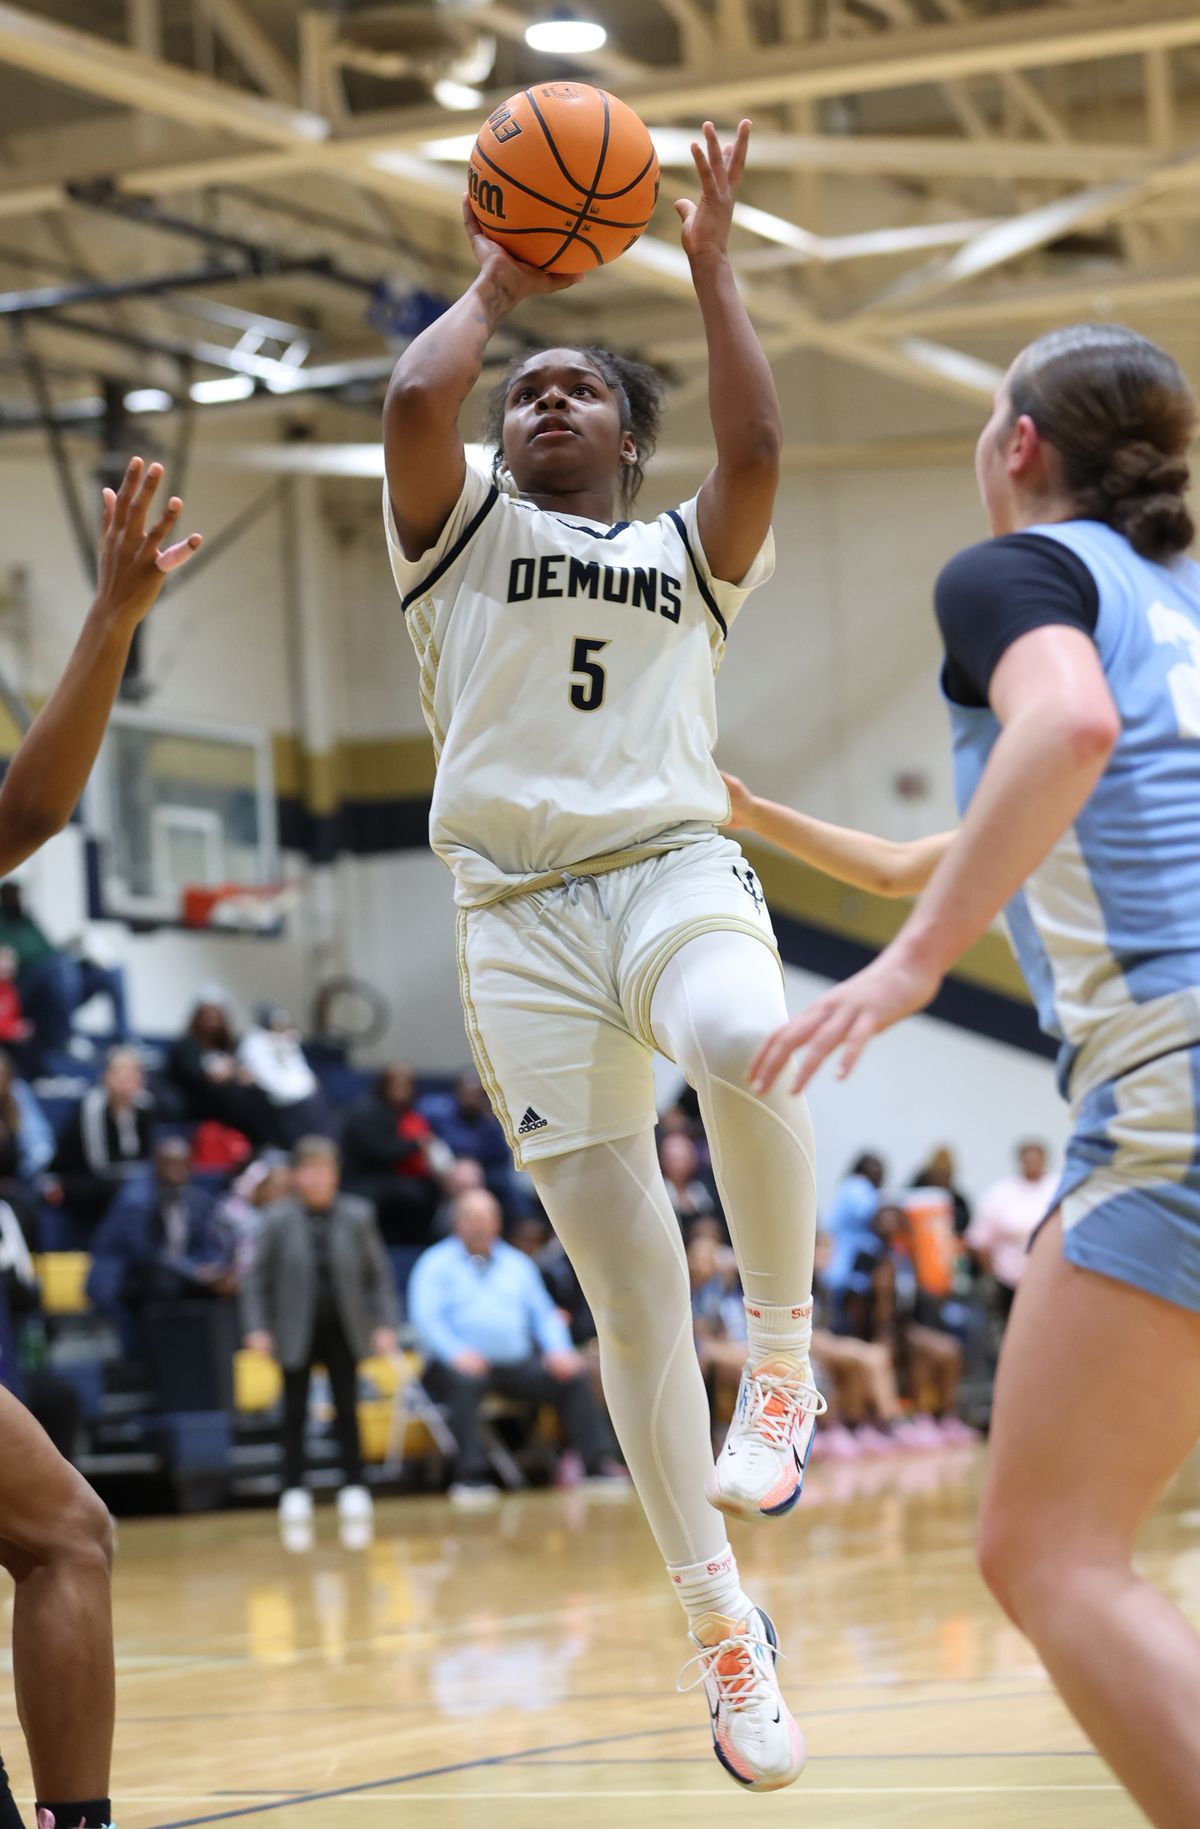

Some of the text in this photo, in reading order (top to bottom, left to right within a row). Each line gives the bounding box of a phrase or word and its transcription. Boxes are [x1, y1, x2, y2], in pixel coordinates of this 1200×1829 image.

[507, 555, 681, 624] DEMONS
[568, 635, 612, 713] 5
[518, 1119, 548, 1134] adidas
